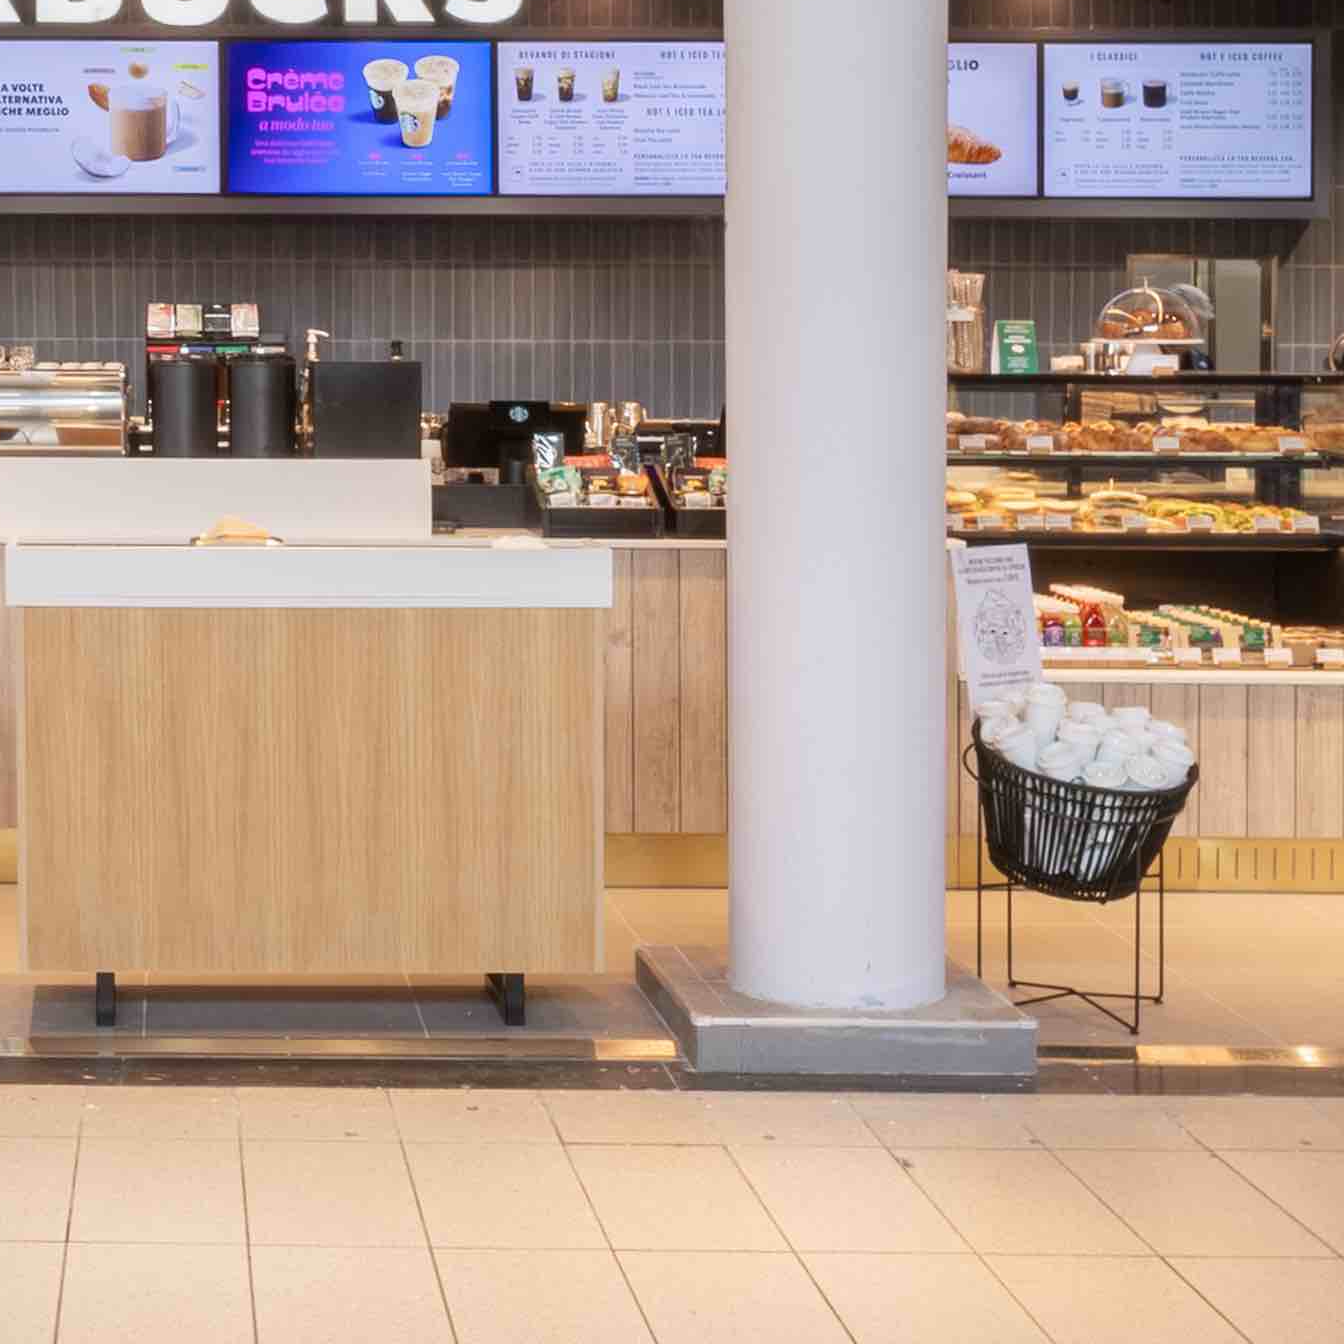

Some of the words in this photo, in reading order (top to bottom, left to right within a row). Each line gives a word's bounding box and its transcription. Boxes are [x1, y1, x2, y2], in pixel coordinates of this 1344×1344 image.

[247, 67, 345, 90] Crème
[0, 83, 9, 93] A
[11, 83, 45, 93] VOLTE
[26, 107, 70, 117] MEGLIO
